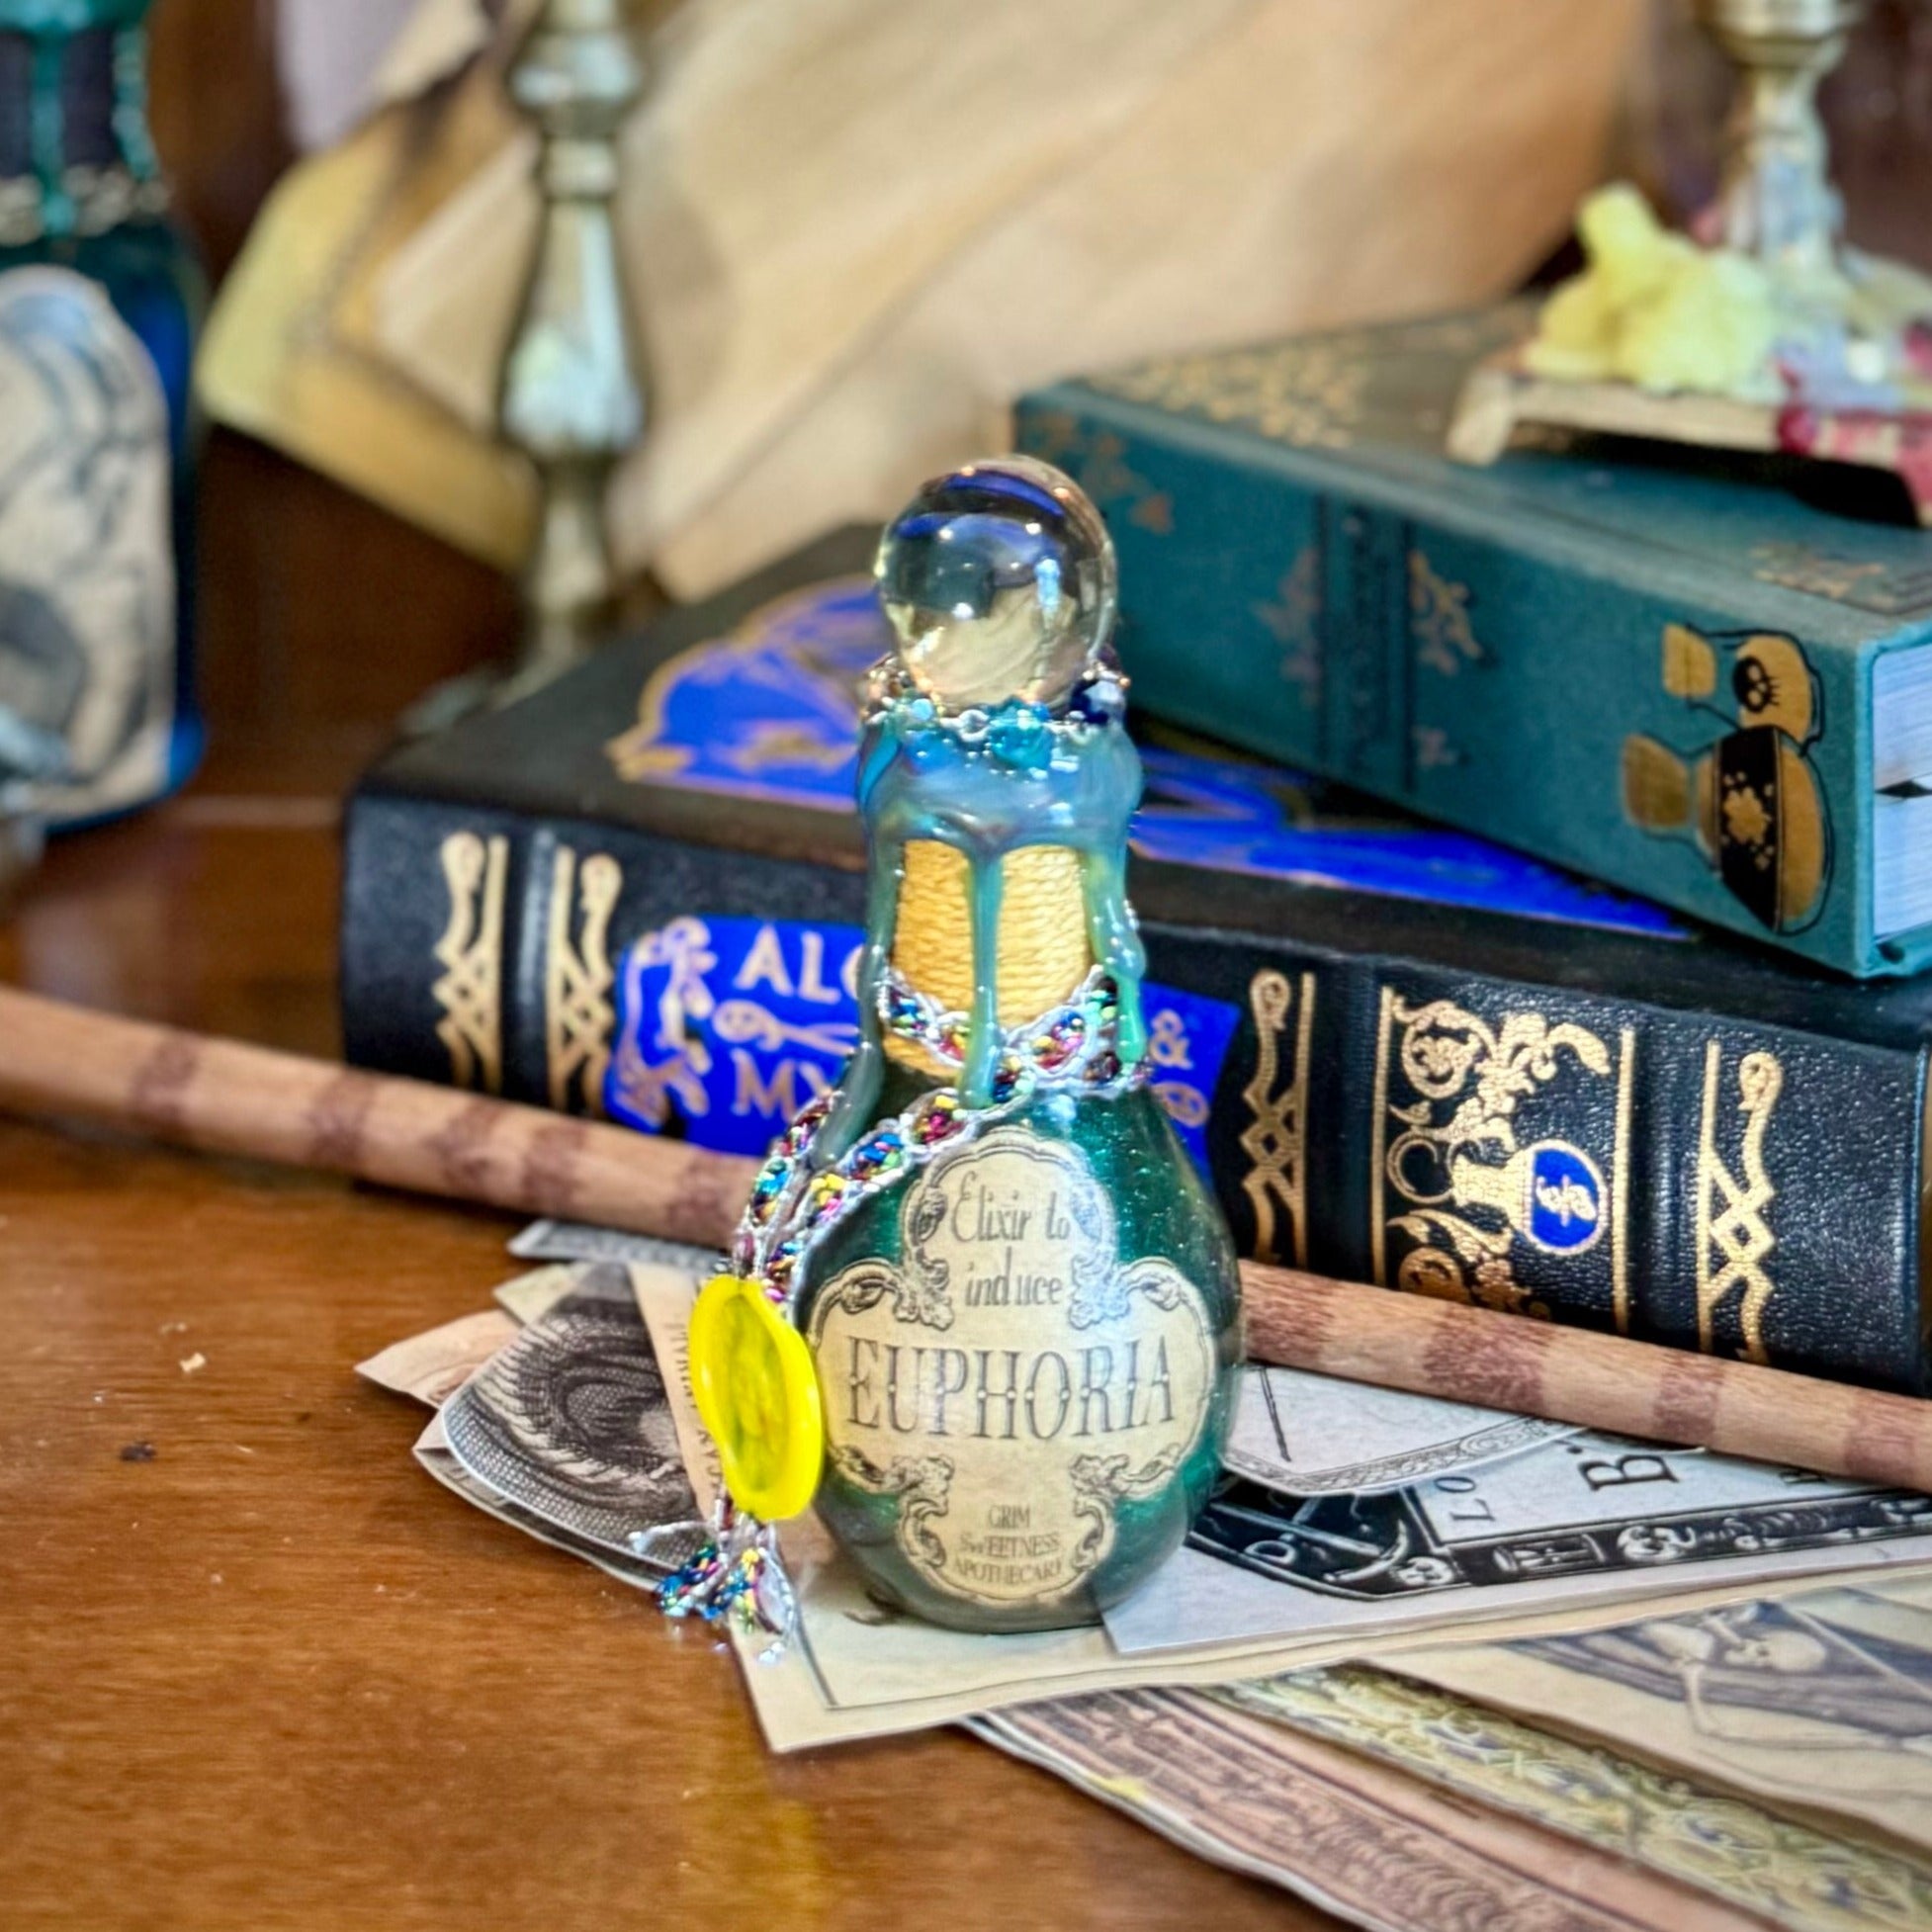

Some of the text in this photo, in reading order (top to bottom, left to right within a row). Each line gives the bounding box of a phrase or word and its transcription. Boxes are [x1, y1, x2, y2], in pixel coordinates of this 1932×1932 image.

[1151, 1009, 1193, 1070] &
[952, 1171, 1071, 1242] Elixir to
[965, 1246, 1063, 1306] induce
[847, 1335, 1175, 1441] EUPHORIA
[989, 1504, 1030, 1529] GRIM
